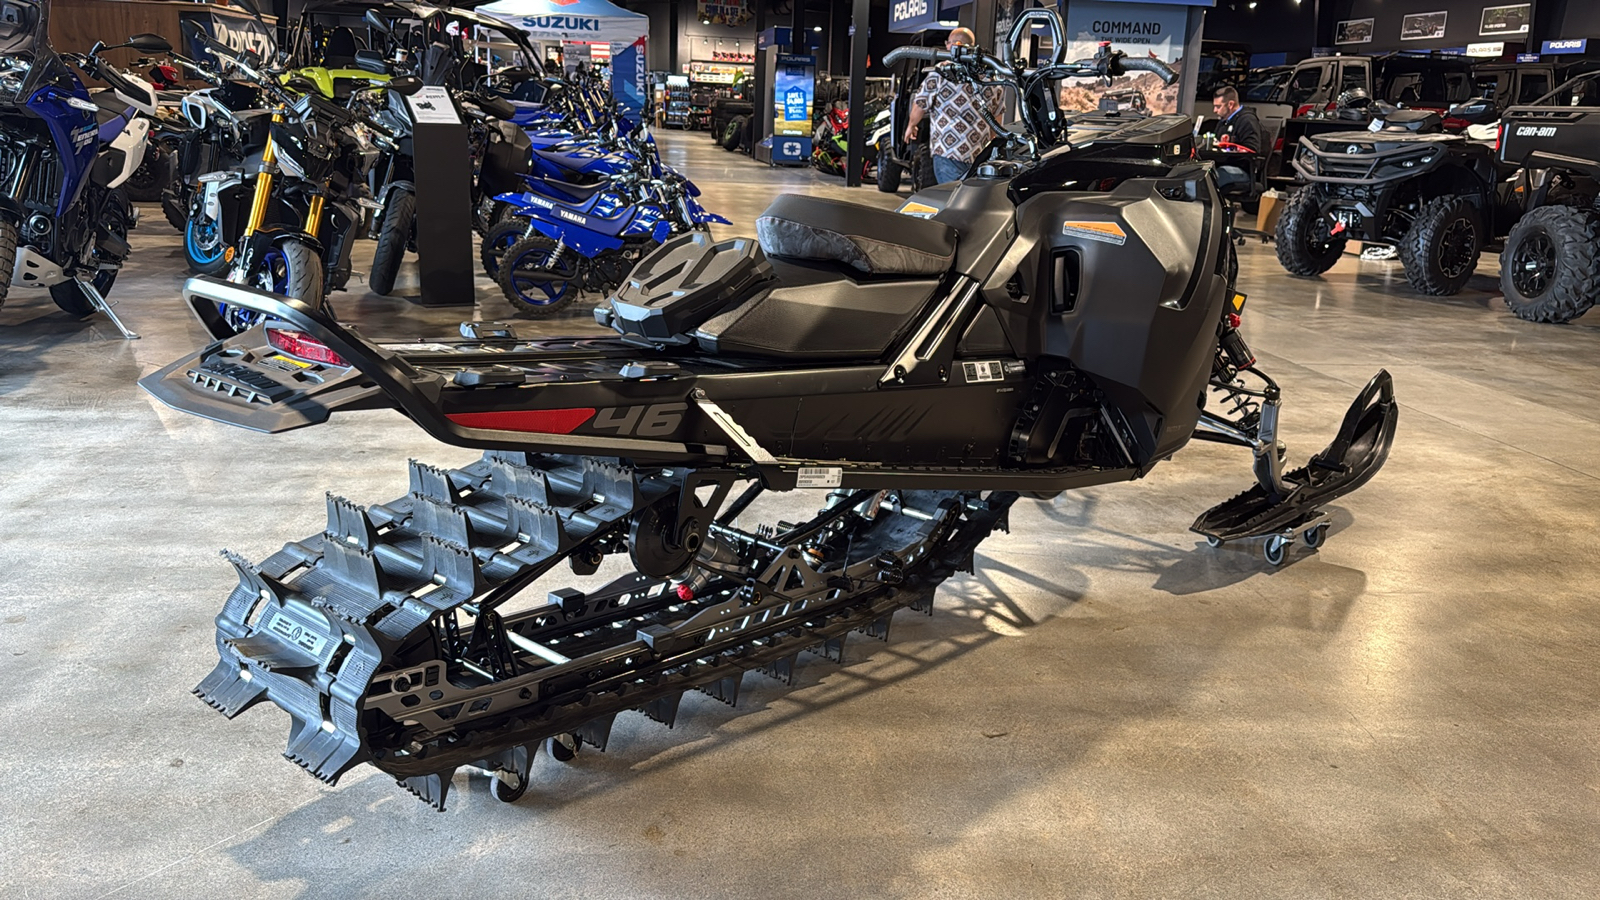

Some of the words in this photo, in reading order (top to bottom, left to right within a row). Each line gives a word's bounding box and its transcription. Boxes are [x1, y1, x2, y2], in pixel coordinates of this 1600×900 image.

[893, 0, 928, 22] POLARIS
[522, 16, 599, 31] SUZUKI
[1092, 20, 1161, 35] COMMAND
[1549, 41, 1581, 49] POLARIS
[635, 45, 645, 96] SUZUKI
[530, 196, 554, 210] YAMAHA
[560, 209, 587, 225] YAMAHA
[592, 402, 689, 436] 46
